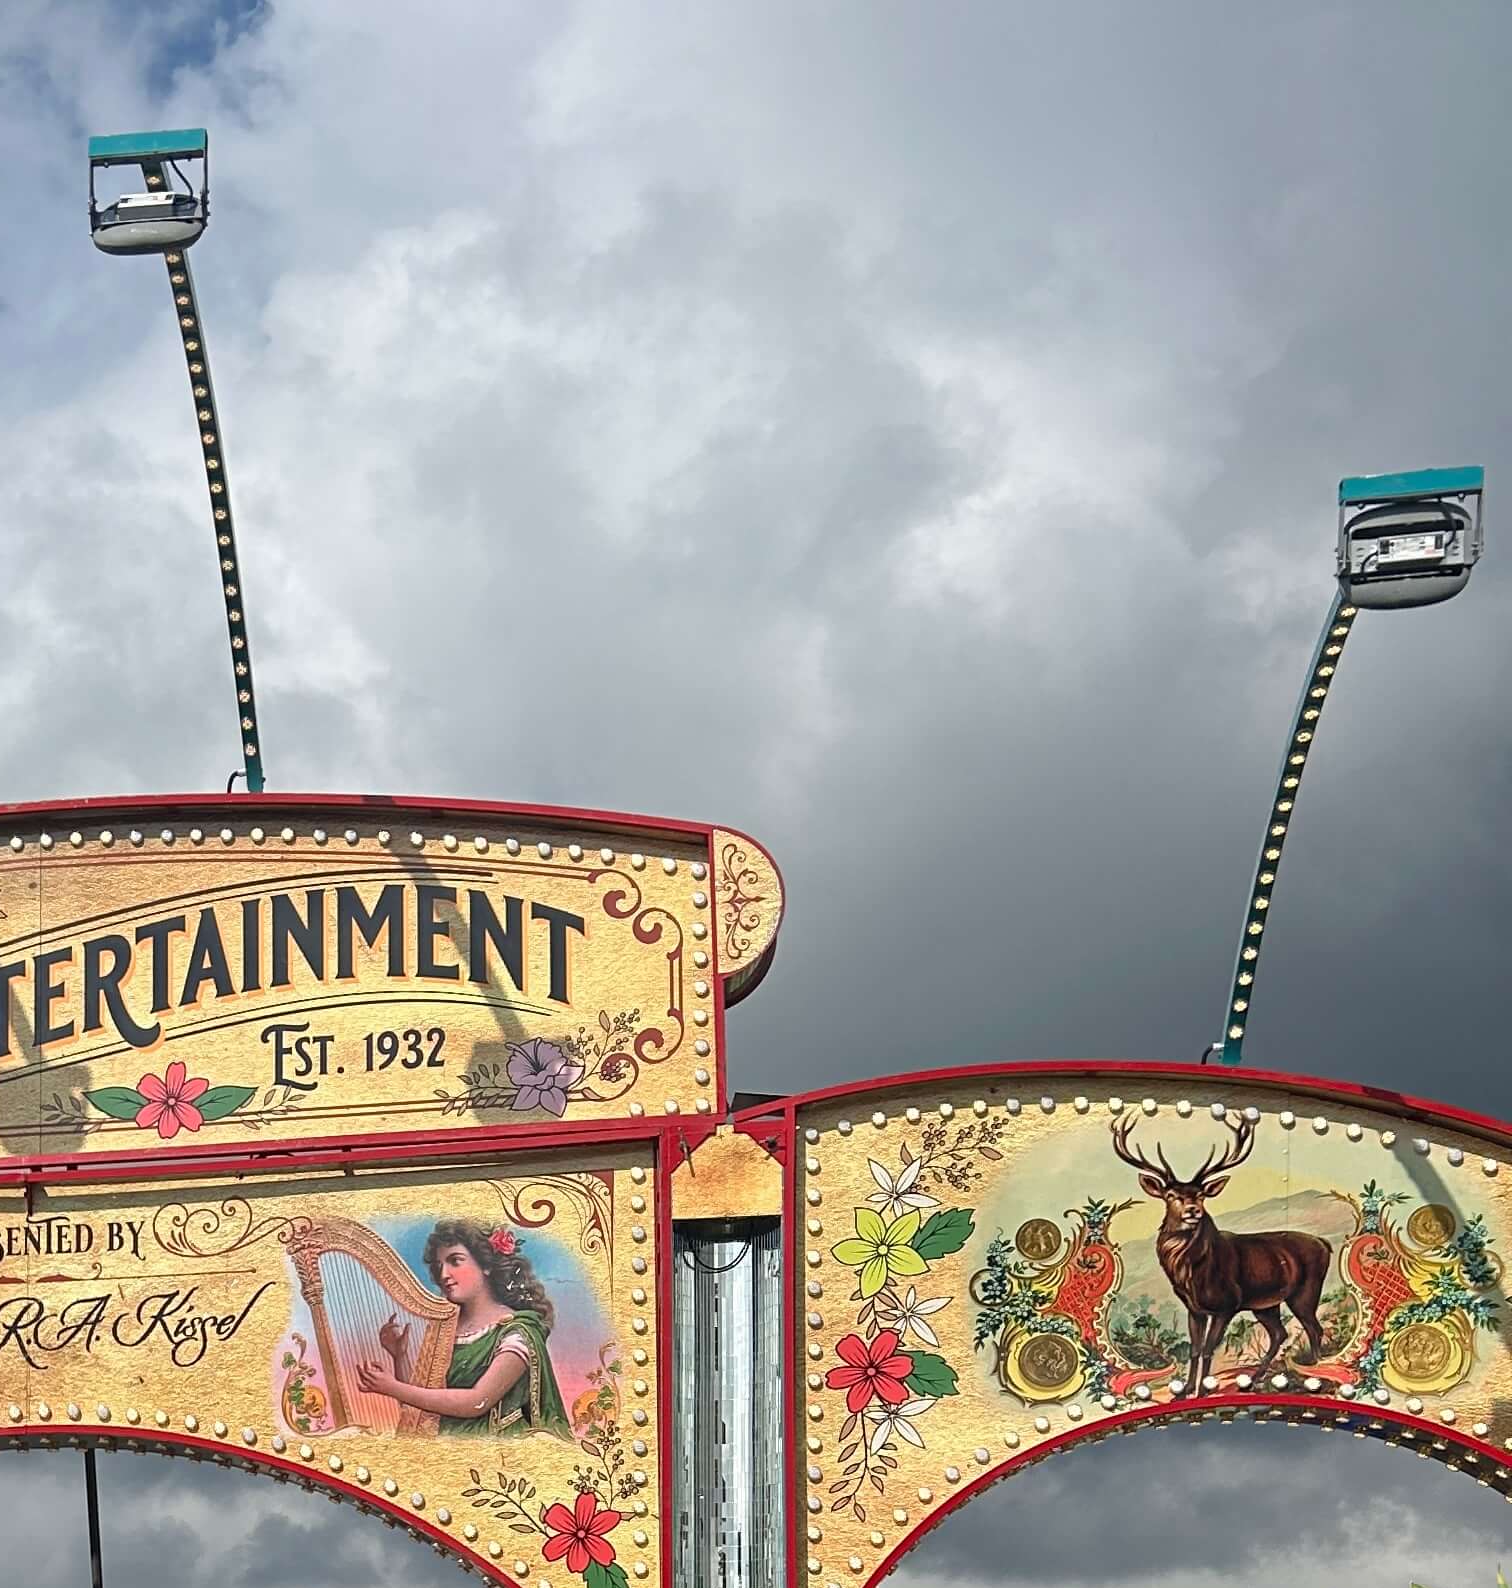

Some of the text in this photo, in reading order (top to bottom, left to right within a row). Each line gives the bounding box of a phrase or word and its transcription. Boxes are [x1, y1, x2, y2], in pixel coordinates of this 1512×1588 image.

[260, 1021, 445, 1090] EST. 1932
[107, 1220, 145, 1261] BY
[112, 1281, 276, 1367] Kissel
